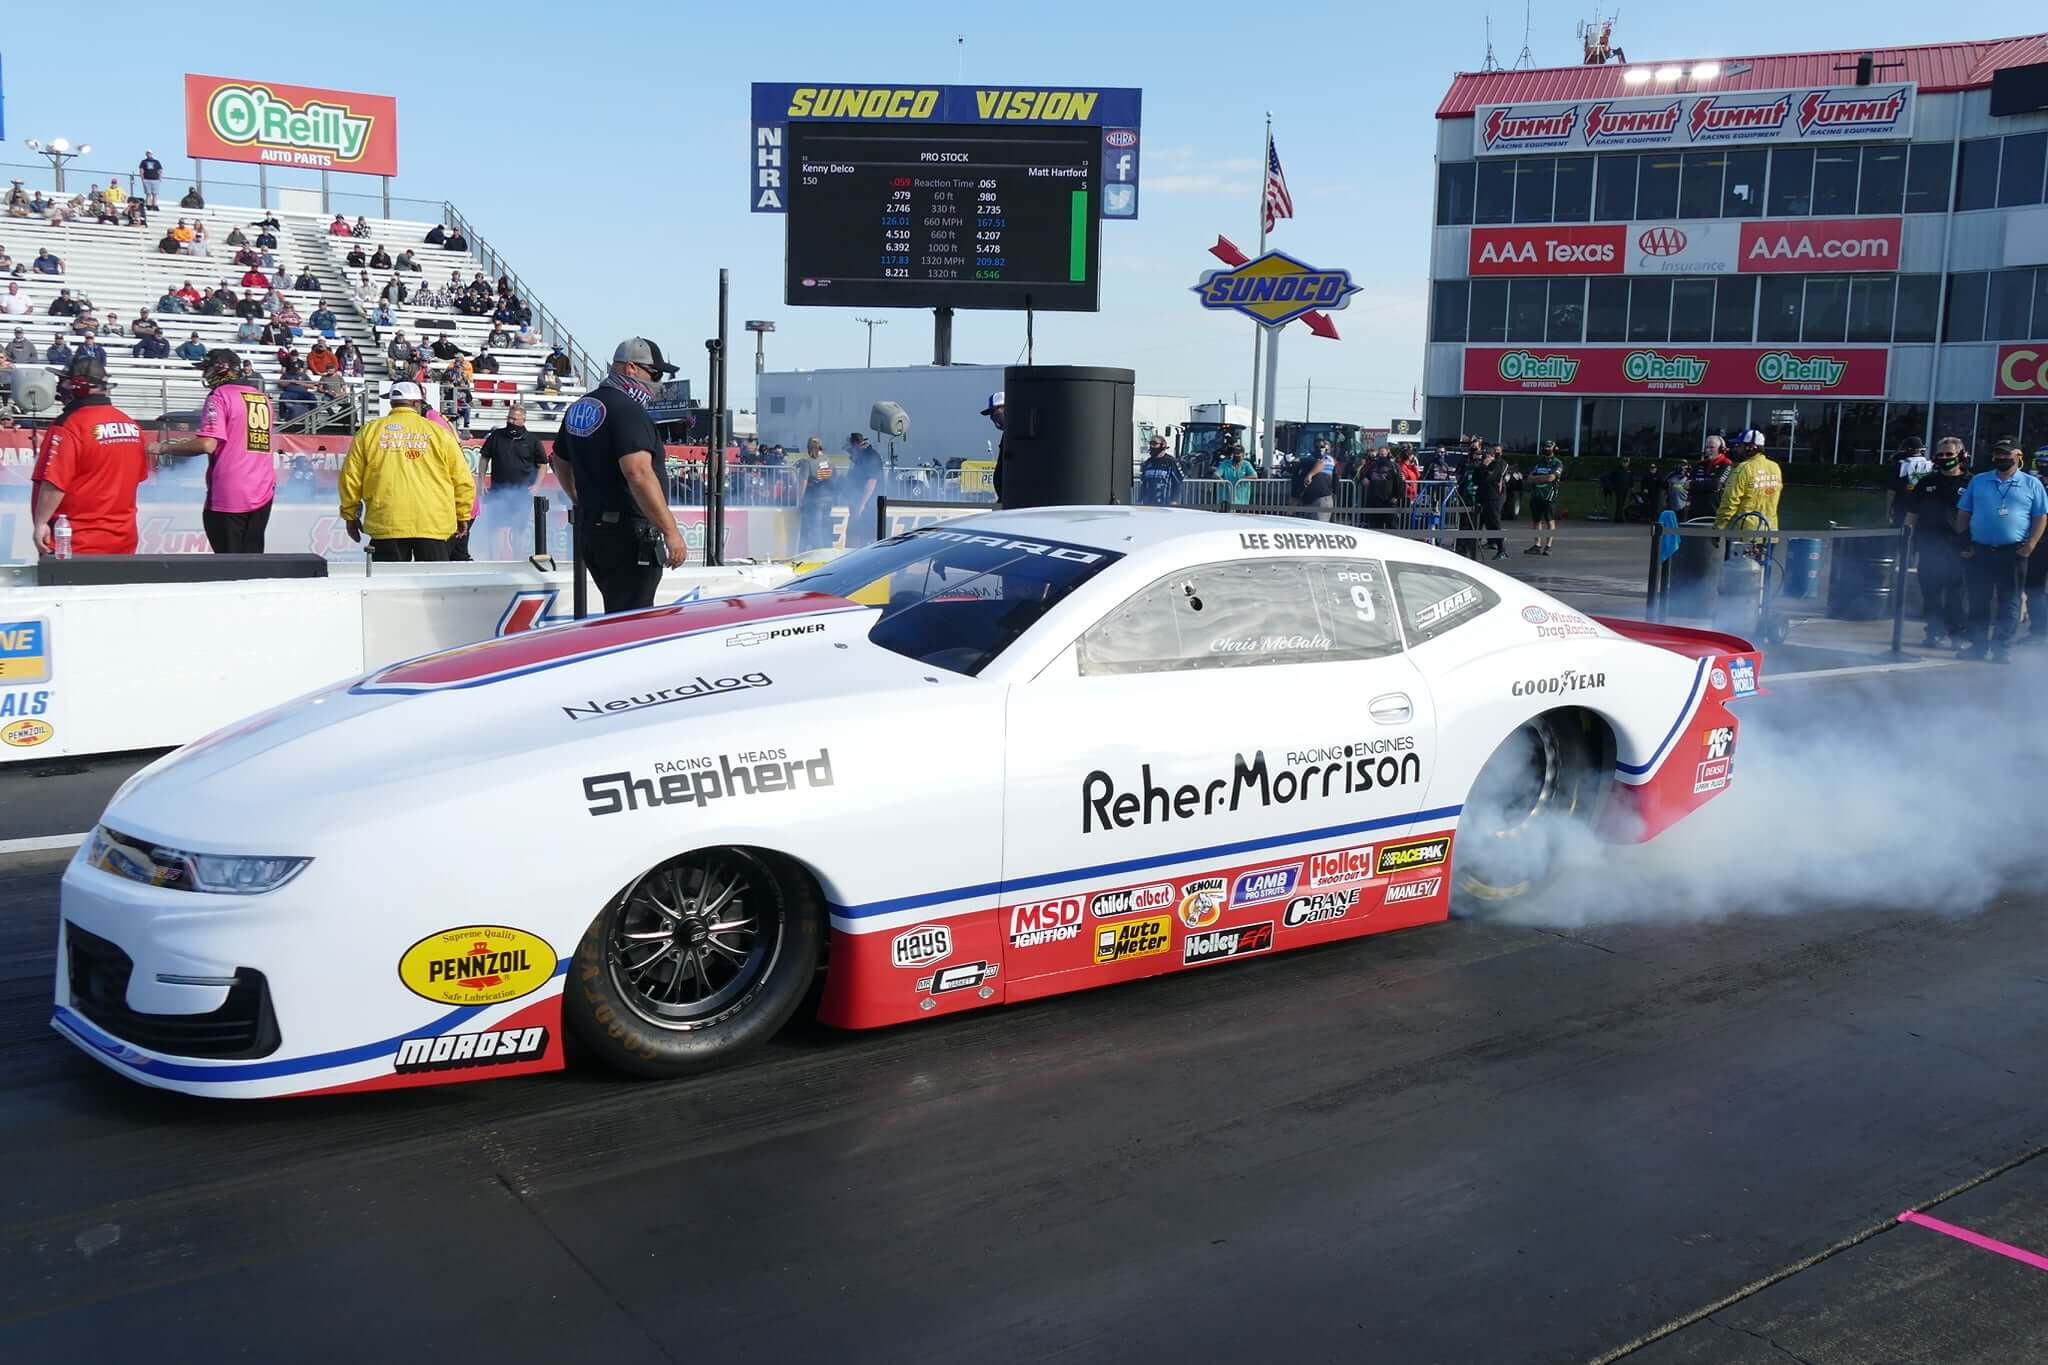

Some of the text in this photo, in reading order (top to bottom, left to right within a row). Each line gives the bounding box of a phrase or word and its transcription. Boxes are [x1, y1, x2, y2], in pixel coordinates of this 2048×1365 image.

[788, 88, 1099, 121] SUNOCO VISION
[217, 93, 363, 153] O'Reilly
[1809, 126, 1894, 136] RACING EQUIPMENT
[1109, 132, 1133, 146] NHRA
[1596, 136, 1672, 145] RACING EQUIPMENT
[1700, 131, 1780, 140] RACING EQUIPMENT
[1495, 141, 1568, 150] RACING EQUIPMENT
[260, 149, 331, 166] AUTO PARTS
[920, 152, 969, 162] PRO STOCK
[757, 127, 782, 208] NHRA
[802, 163, 855, 175] Kenny Delco
[1028, 167, 1088, 177] Matt Hartford
[802, 176, 818, 185] 150
[914, 178, 951, 188] Reaction
[953, 179, 975, 188] Time
[977, 180, 997, 189] .065
[1081, 182, 1088, 190] 5
[891, 191, 997, 202] .979 60 ft .980
[886, 204, 1001, 215] 2.746 330 ft 2.735
[924, 218, 940, 227] 660
[942, 218, 963, 227] MPH
[886, 230, 1001, 241] 4.510 660 ft 4.207
[1642, 230, 1685, 255] AAA
[886, 243, 1001, 254] 6.392 1000 ft 5.478
[1479, 239, 1615, 264] AAA Texas
[1748, 236, 1889, 260] AAA.com
[921, 257, 942, 265] 1320
[944, 257, 965, 265] MPH
[976, 258, 1005, 267] 209.82
[1661, 260, 1726, 272] Insurance
[885, 268, 1000, 279] 8.221 1320 ft 6.546
[1209, 276, 1343, 302] SUNOCO
[1502, 355, 1577, 380] O'Reilly
[1627, 355, 1707, 382] O'Reilly
[1761, 355, 1841, 382] O'Reilly
[248, 402, 270, 431] 60
[249, 431, 269, 444] YEARS
[1241, 532, 1358, 550] LEE SHEPHERD
[1337, 572, 1373, 582] PRO
[1350, 586, 1375, 621] 9
[770, 623, 825, 640] POWER
[1536, 624, 1566, 639] Drag
[1210, 637, 1258, 652] Chris
[562, 671, 773, 721] Neuralog
[8, 726, 46, 740] PENNZOIL
[1287, 736, 1414, 767] RACING ENGINES
[654, 748, 788, 774] RACING HEADS
[582, 748, 834, 817] Shepherd
[1391, 844, 1444, 865] RACEPAK
[1312, 851, 1370, 878] Holley
[1245, 872, 1288, 892] LAMB
[1345, 871, 1360, 881] OUT
[1186, 879, 1223, 896] VENOLIA
[1245, 887, 1285, 900] PRO STRUTS
[1386, 881, 1432, 902] MANLEY
[1014, 899, 1081, 934] MSD
[442, 929, 517, 943] Supreme Quality
[1013, 926, 1080, 948] IGNITION
[1119, 921, 1160, 941] Auto
[1116, 935, 1168, 957] Meter
[1186, 932, 1240, 957] Holley
[429, 949, 531, 983] PENNZOIL
[442, 989, 516, 1002] Safe Lubrication
[394, 1026, 546, 1068] MOROSO
